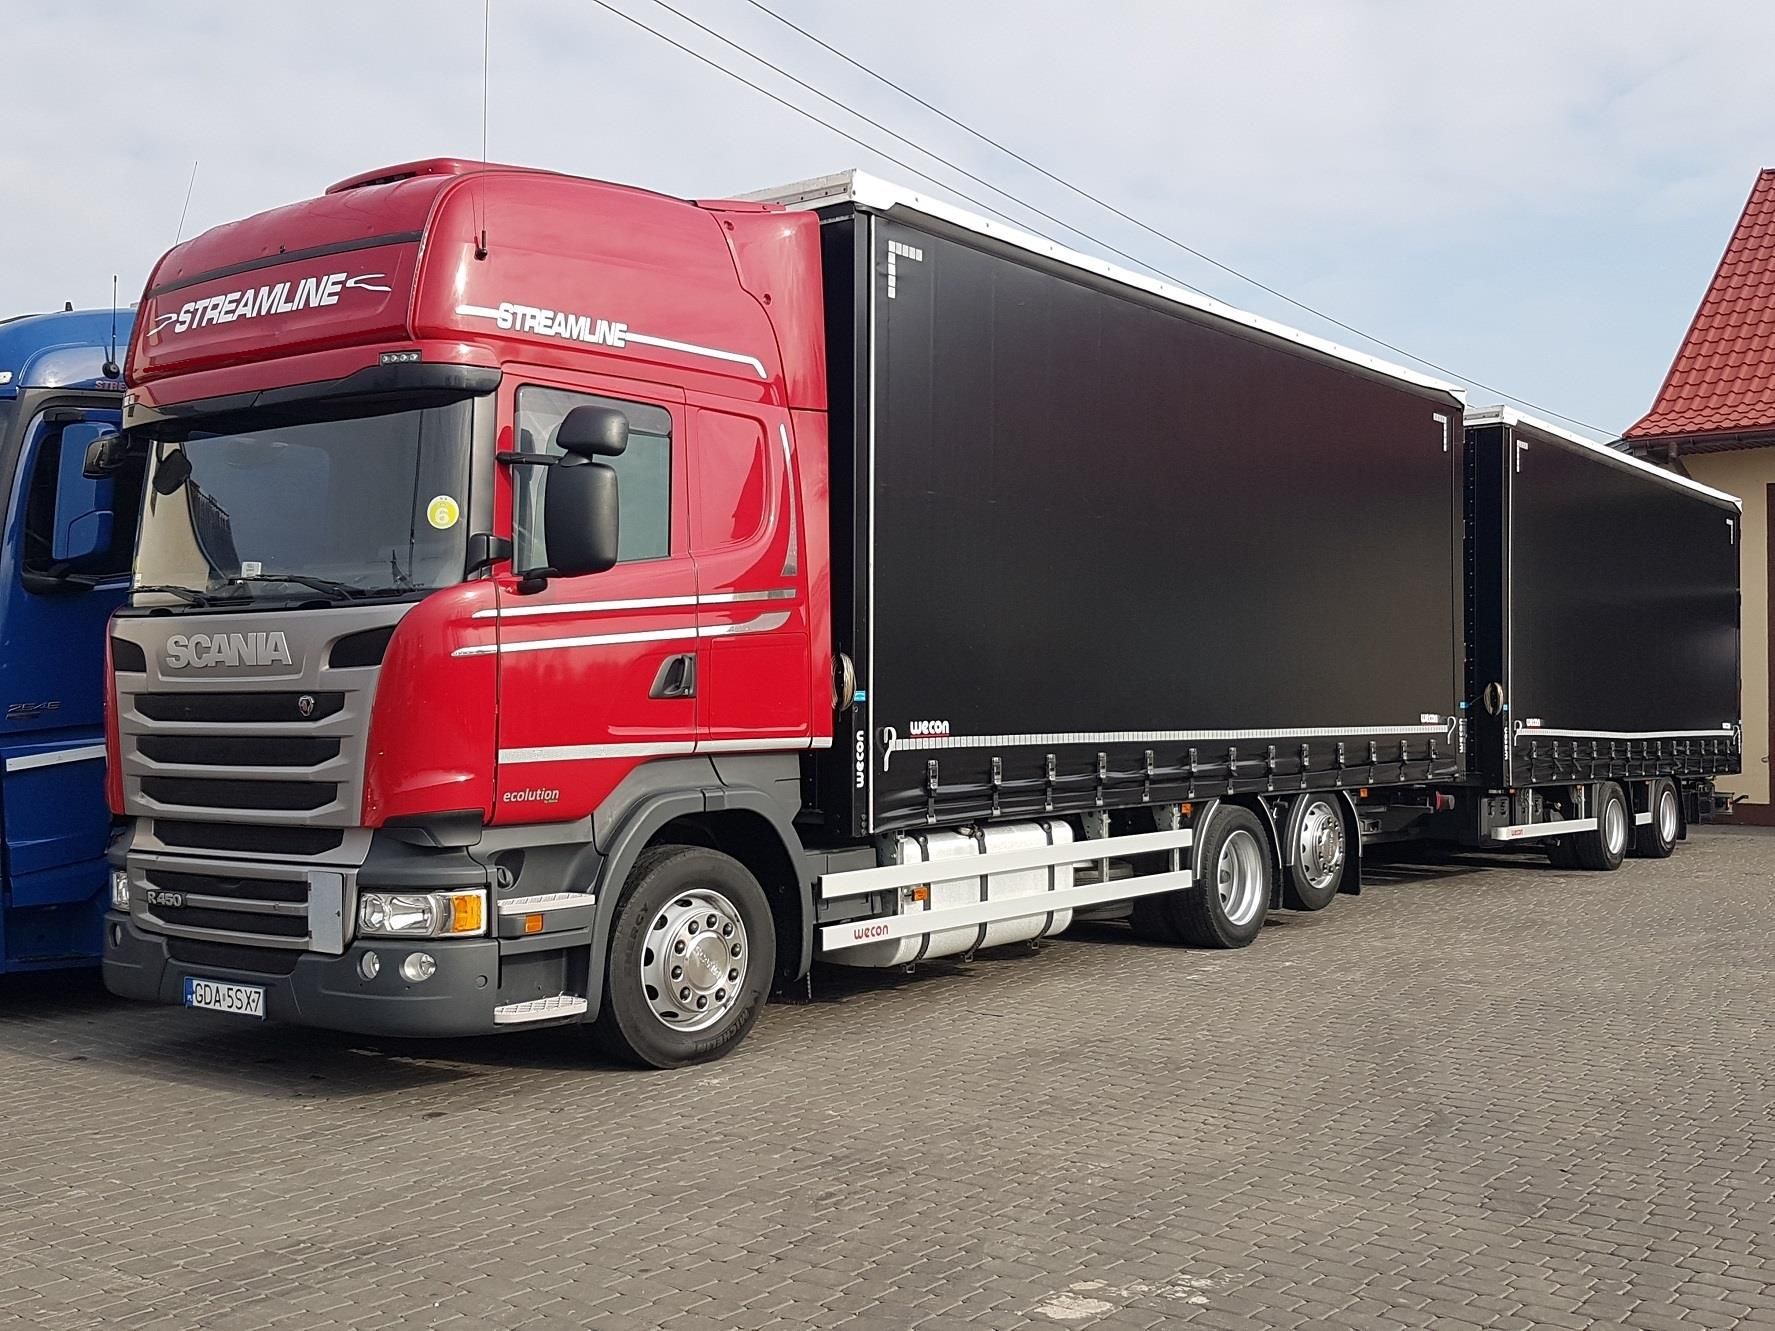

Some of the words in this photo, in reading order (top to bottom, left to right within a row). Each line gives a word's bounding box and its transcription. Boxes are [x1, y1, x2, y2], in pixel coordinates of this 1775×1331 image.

[174, 272, 348, 333] STREAMLINE
[496, 302, 628, 348] STREAMLINE
[95, 380, 128, 391] STRE
[166, 631, 293, 669] SCANIA
[909, 720, 950, 735] wecon
[856, 730, 865, 789] wecon
[503, 788, 560, 802] ecolution
[853, 924, 889, 940] wecon
[195, 982, 222, 1008] GDA
